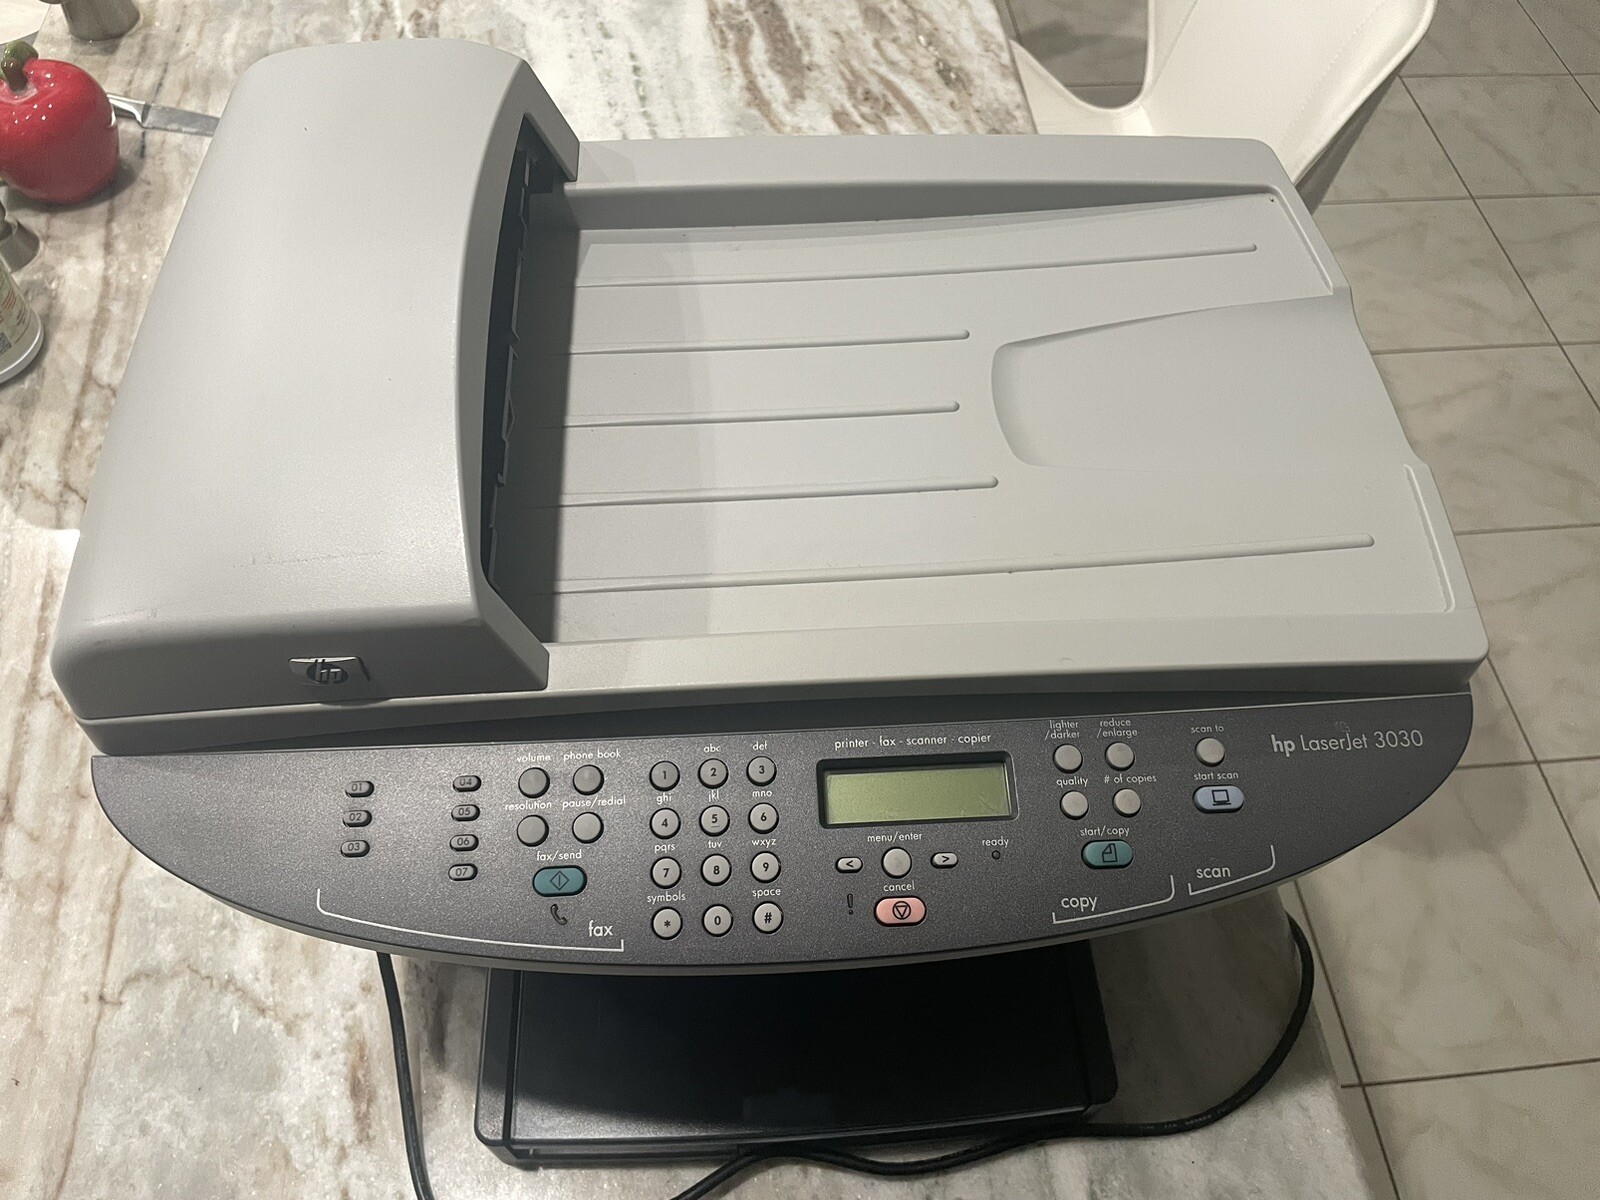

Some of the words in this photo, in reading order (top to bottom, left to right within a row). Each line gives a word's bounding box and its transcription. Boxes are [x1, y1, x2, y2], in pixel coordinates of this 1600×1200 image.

[1050, 720, 1078, 731] lighter
[1100, 718, 1131, 727] reduce
[1097, 728, 1138, 739] /enlarge
[1191, 726, 1213, 734] scan
[1215, 725, 1225, 733] to
[1044, 730, 1080, 741] /darker
[752, 741, 768, 750] def
[835, 739, 869, 751] printer
[879, 736, 896, 746] fax
[906, 736, 947, 745] scanner
[958, 734, 991, 744] copier
[1271, 734, 1296, 757] hp
[1300, 732, 1368, 751] LaserJet
[1373, 729, 1424, 748] 3030
[703, 744, 721, 753] abc
[516, 752, 552, 763] volume
[563, 751, 593, 762] phone
[597, 749, 622, 758] book
[710, 768, 717, 777] 2
[759, 765, 765, 774] 3
[662, 771, 667, 779] 1
[1104, 775, 1109, 784] #
[1114, 774, 1123, 784] of
[1126, 773, 1157, 785] copies
[1194, 771, 1215, 781] start
[1217, 772, 1239, 780] scan
[351, 783, 362, 791] 01
[460, 778, 472, 786] 04
[1056, 776, 1089, 788] quality
[656, 792, 672, 805] ghi
[708, 790, 720, 802] jkl
[752, 789, 773, 798] mno
[505, 801, 552, 811] resolution
[562, 795, 626, 809] pause/redial
[458, 807, 470, 816] 05
[760, 812, 767, 821] 6
[349, 813, 362, 821] 02
[711, 814, 718, 823] 5
[661, 818, 668, 827] 4
[1080, 826, 1130, 837] start/copy
[457, 837, 469, 846] 06
[867, 831, 922, 843] menu/enter
[982, 836, 1009, 847] ready
[347, 843, 360, 851] 03
[654, 842, 676, 853] pqrs
[708, 840, 723, 848] tuv
[751, 838, 777, 847] wxyz
[536, 849, 582, 862] fax/send
[455, 868, 468, 876] 07
[713, 865, 720, 875] 8
[763, 862, 769, 872] 9
[1196, 866, 1231, 878] scan
[663, 868, 670, 878] 7
[883, 881, 915, 892] cancel
[647, 890, 686, 902] symbols
[752, 888, 782, 898] space
[1061, 897, 1097, 912] copy
[714, 916, 721, 925] 0
[764, 912, 772, 924] #
[588, 920, 613, 937] fax
